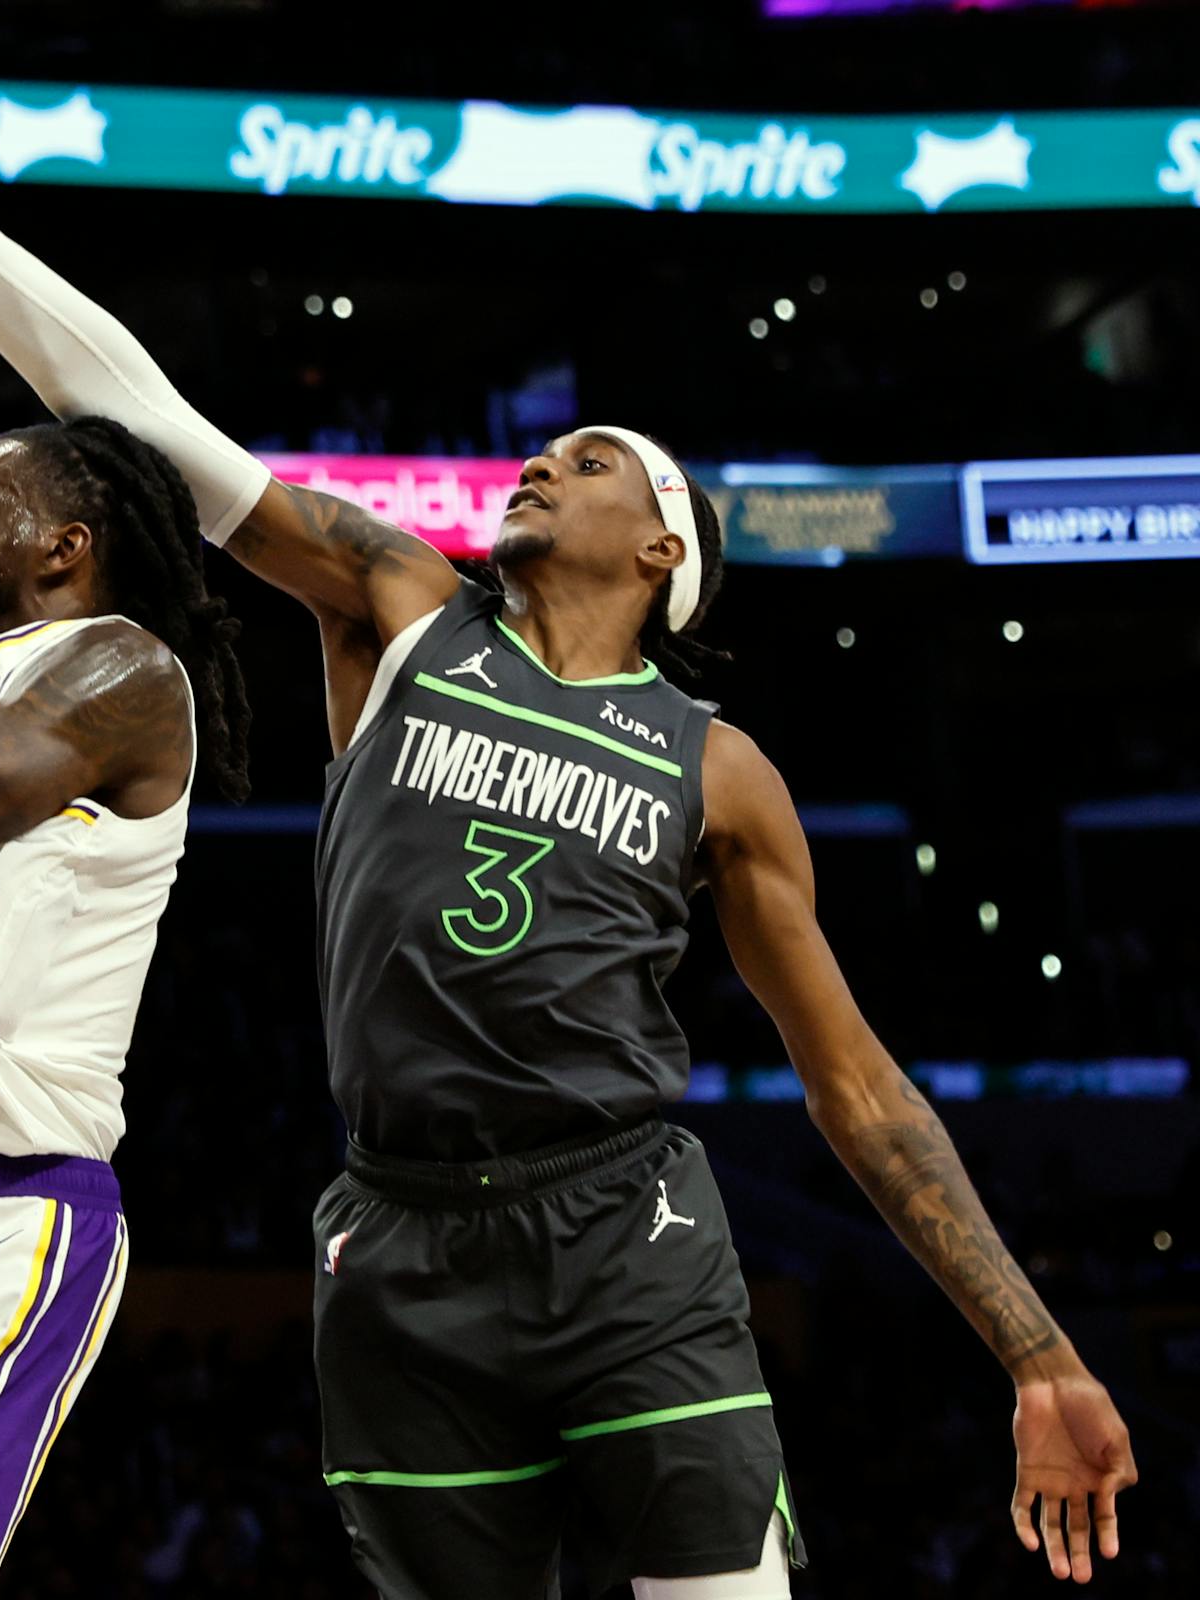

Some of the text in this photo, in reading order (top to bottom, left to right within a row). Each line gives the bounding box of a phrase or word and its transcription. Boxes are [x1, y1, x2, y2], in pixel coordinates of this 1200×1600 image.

[229, 103, 433, 196] Sprite
[650, 119, 847, 213] Sprite
[391, 715, 671, 866] TIMBERWOLVES
[441, 819, 556, 957] 3
